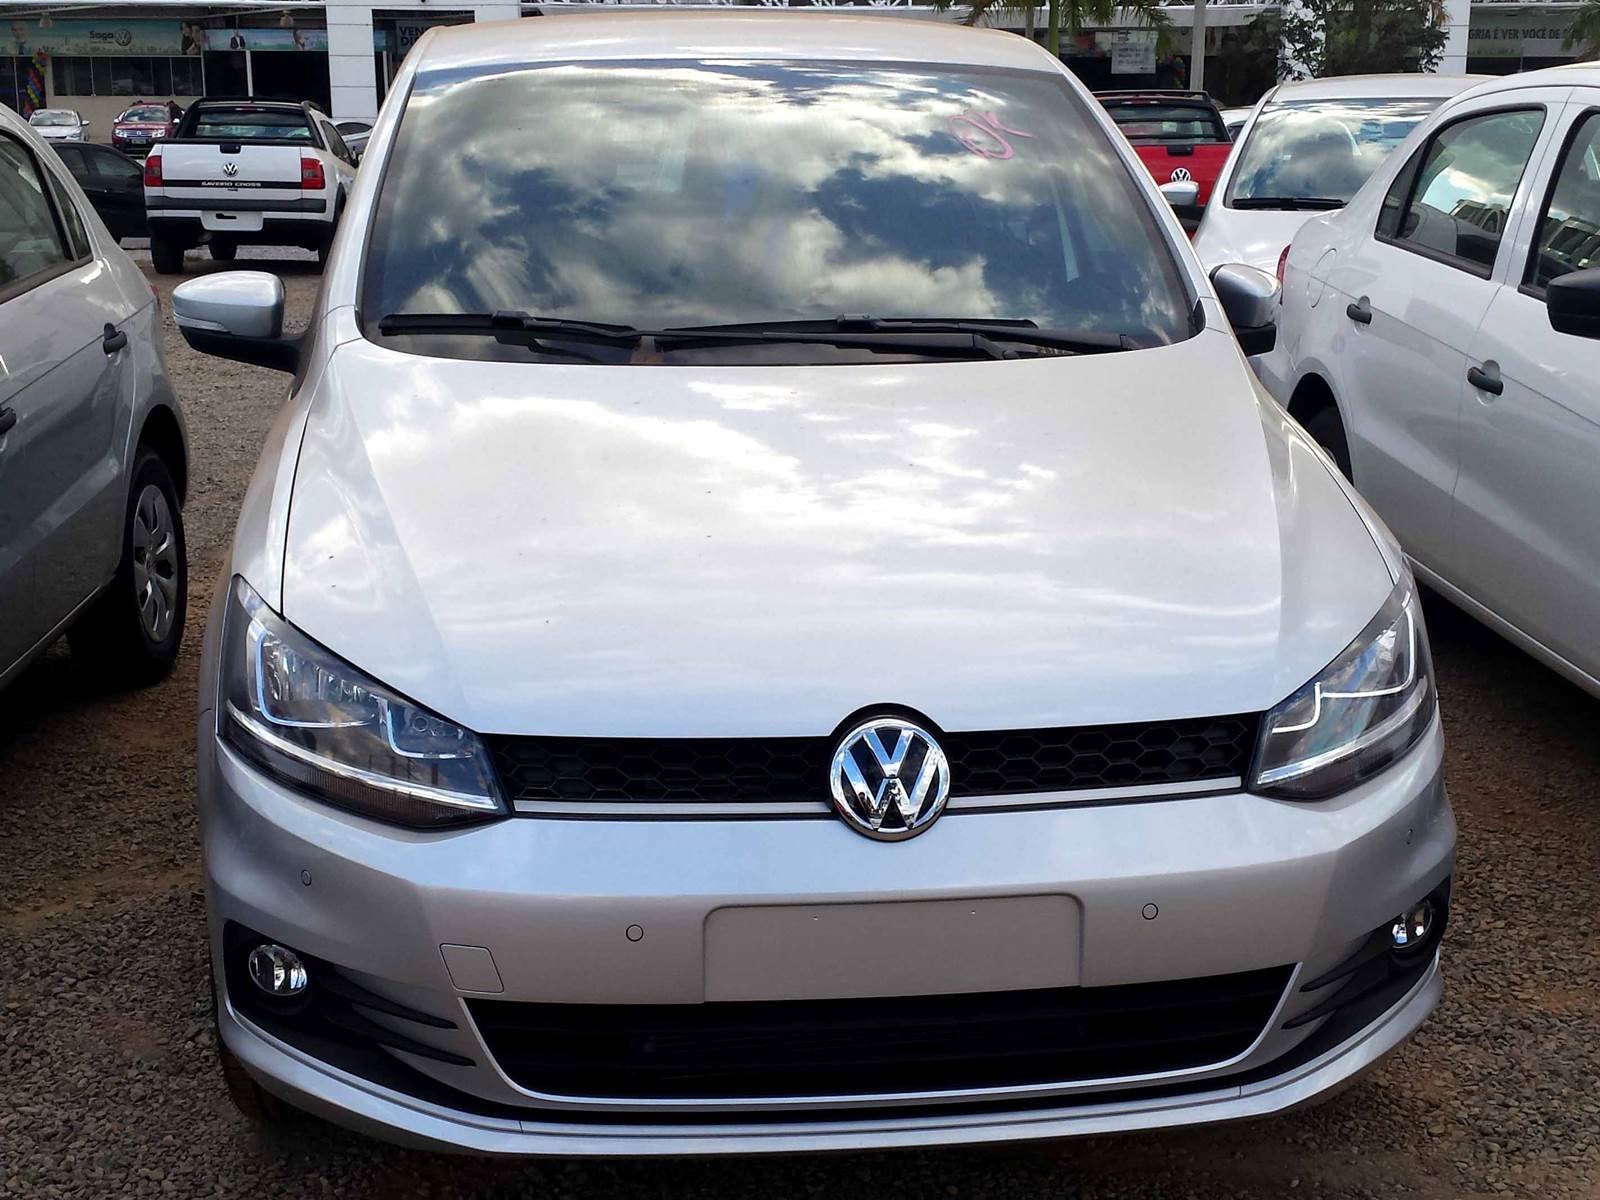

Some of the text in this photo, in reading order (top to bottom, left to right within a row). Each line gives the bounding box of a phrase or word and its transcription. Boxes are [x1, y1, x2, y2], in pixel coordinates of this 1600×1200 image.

[1501, 29, 1519, 40] VER
[1522, 26, 1547, 40] VOCÊ
[1548, 29, 1561, 40] DE
